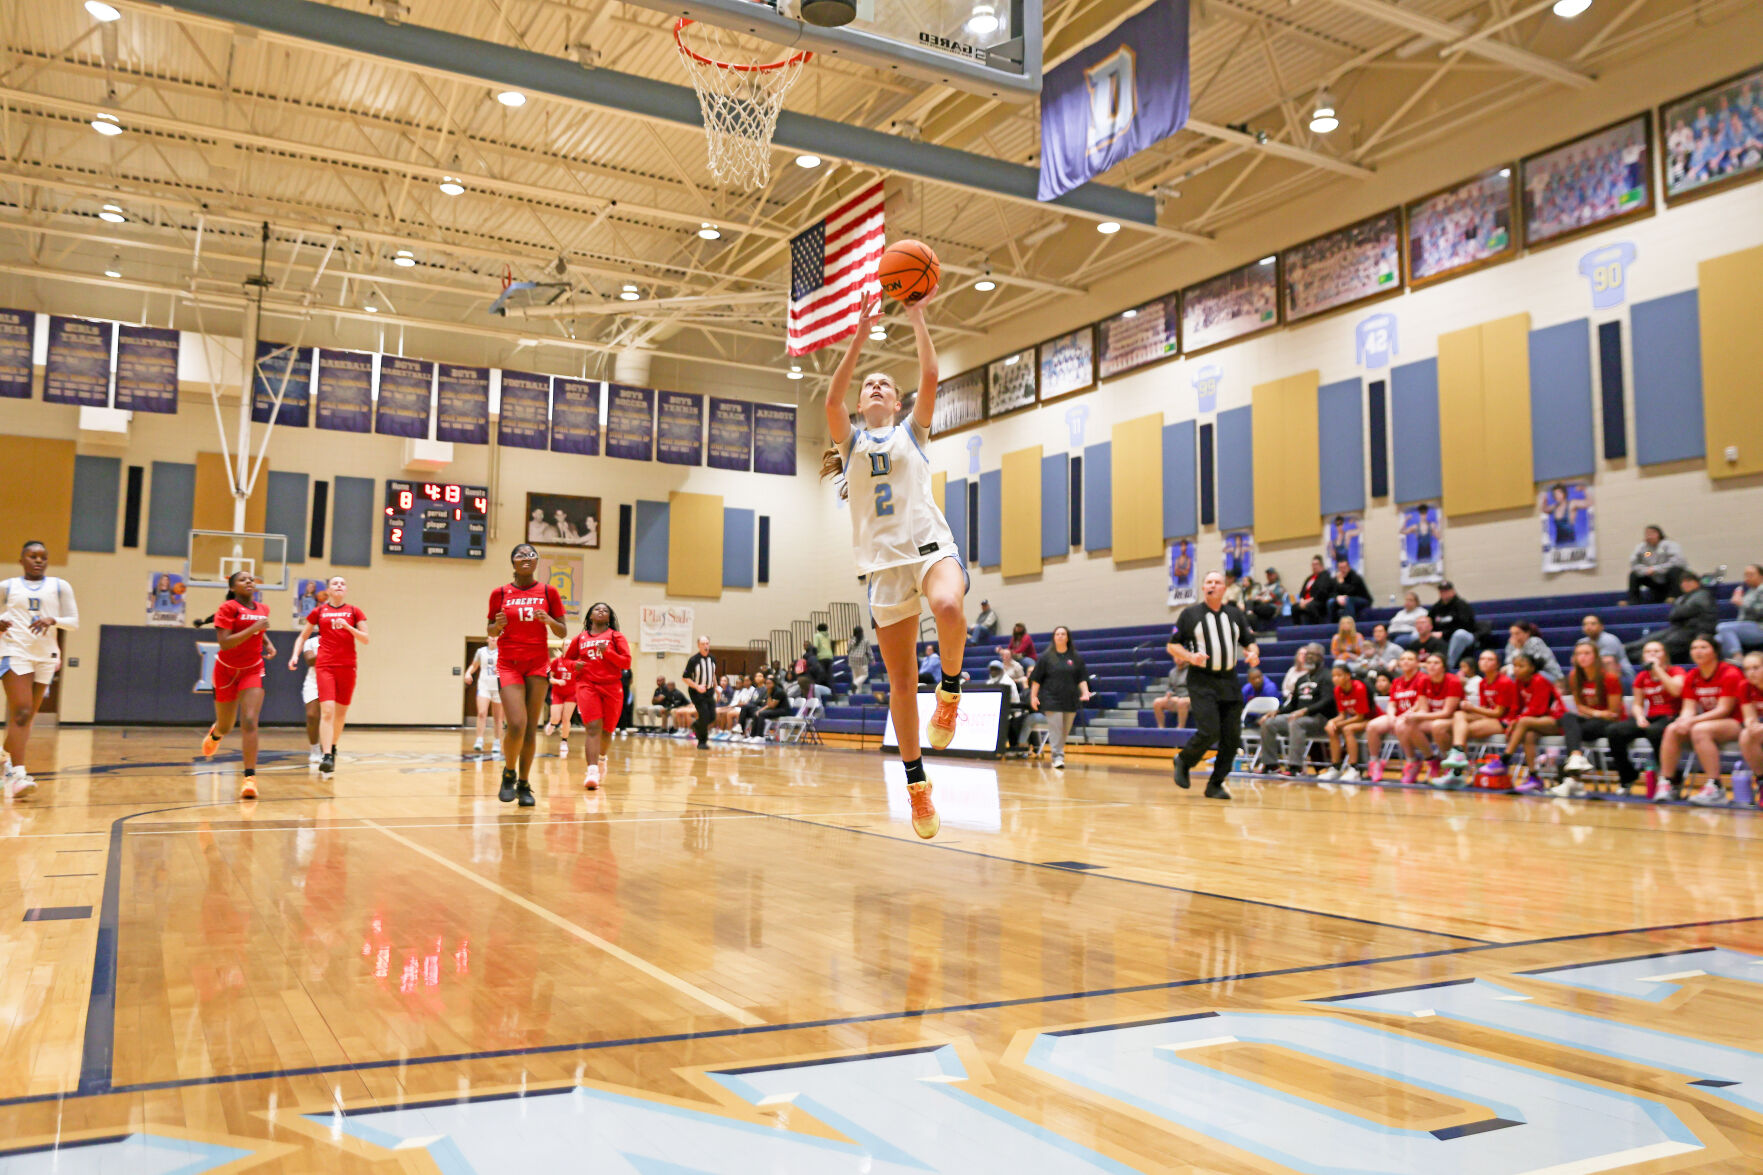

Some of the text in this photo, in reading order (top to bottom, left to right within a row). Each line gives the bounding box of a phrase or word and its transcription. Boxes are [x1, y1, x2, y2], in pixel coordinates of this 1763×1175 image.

[1593, 262, 1622, 292] 90
[320, 358, 372, 372] BASEBALL
[869, 452, 892, 477] D
[400, 491, 413, 510] 8
[424, 483, 461, 503] 4:13
[874, 482, 895, 517] 2
[474, 497, 488, 514] 4
[391, 528, 403, 543] 2
[28, 598, 41, 611] D
[506, 598, 545, 606] LIBERTY
[518, 607, 534, 622] 13
